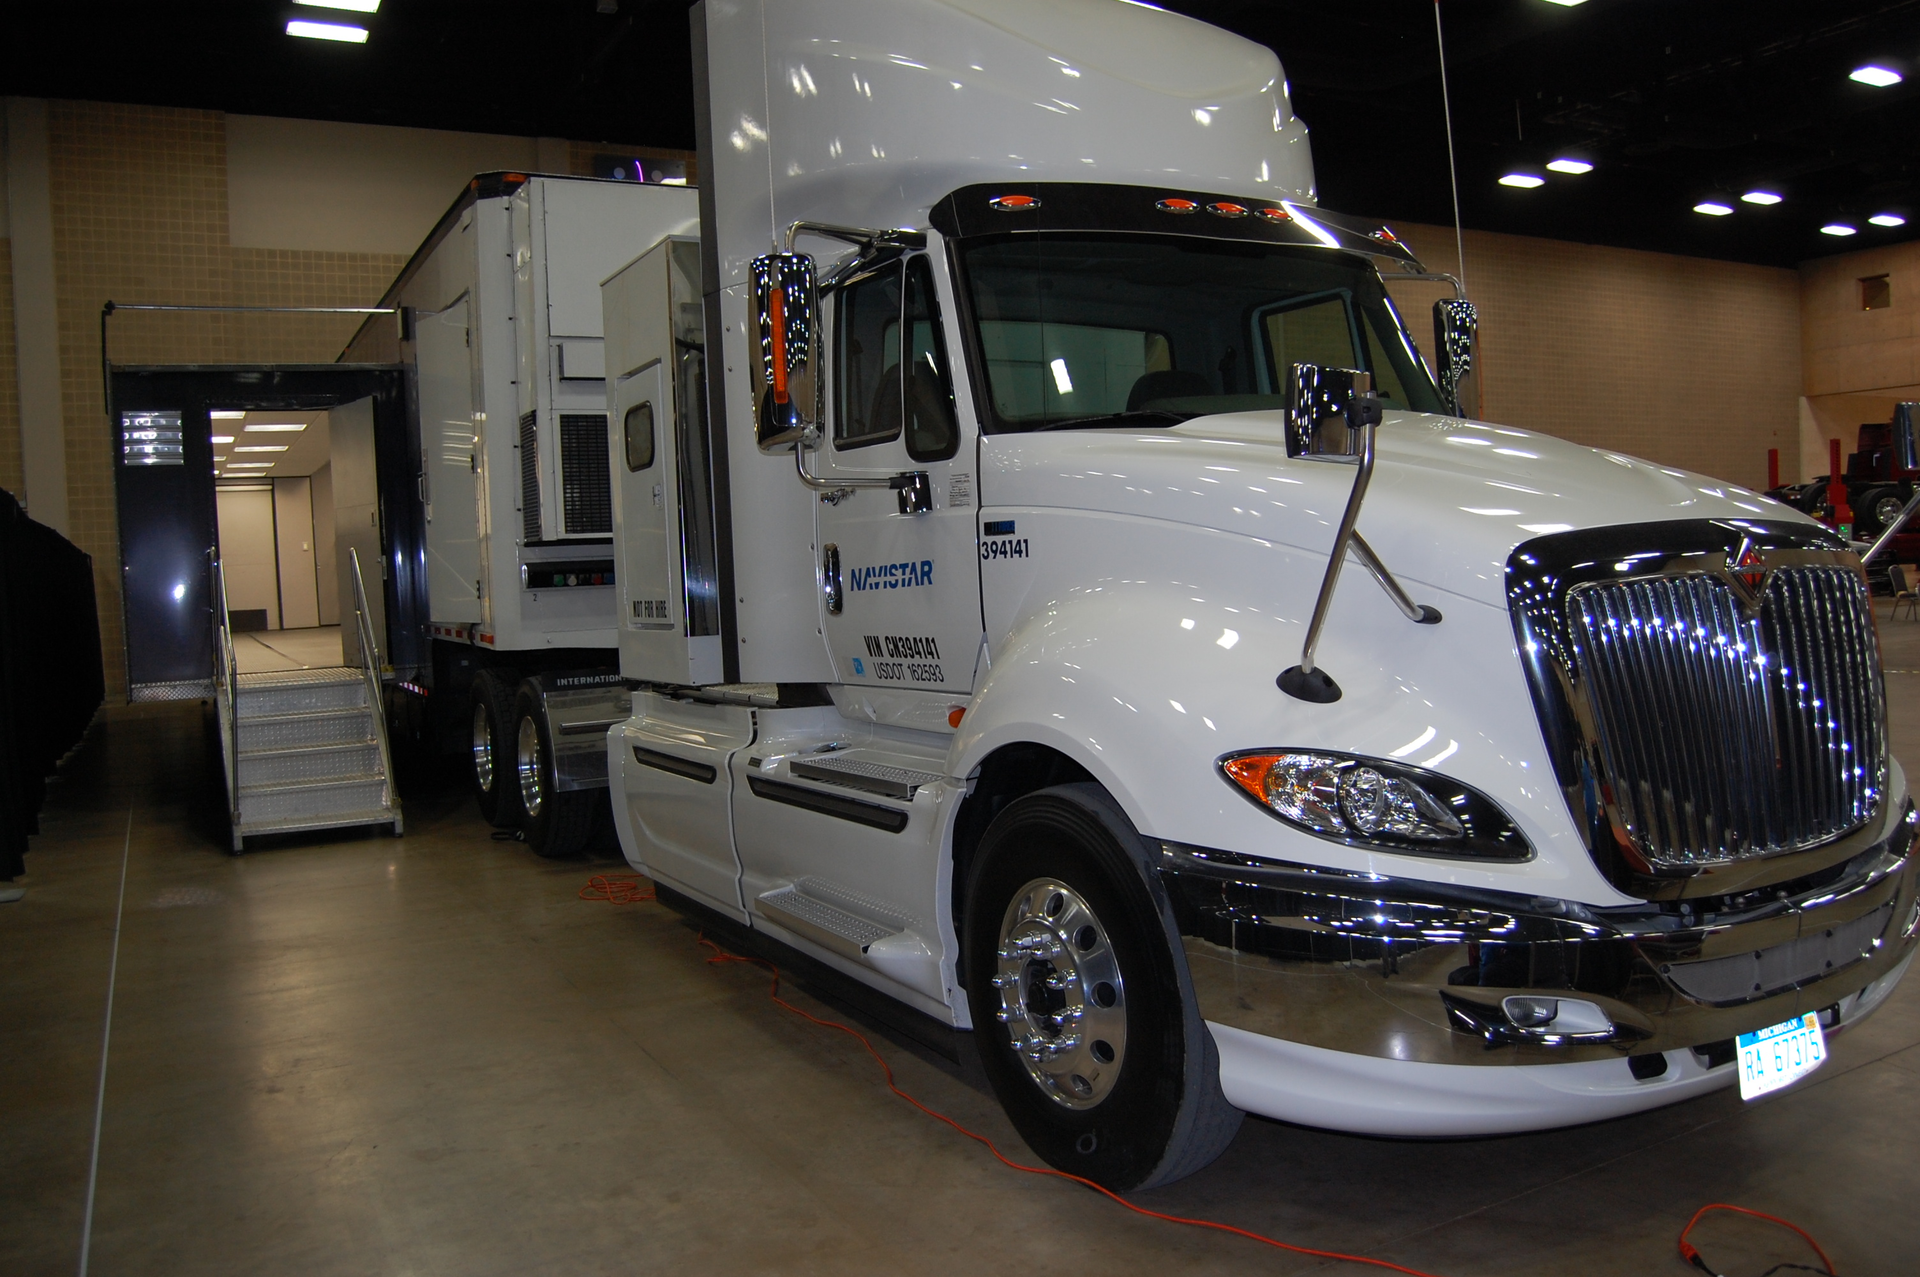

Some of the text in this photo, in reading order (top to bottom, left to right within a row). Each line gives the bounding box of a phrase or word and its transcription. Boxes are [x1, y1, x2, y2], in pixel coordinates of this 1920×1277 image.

[981, 538, 1029, 560] 394141
[850, 559, 933, 592] NAVISTAR
[633, 600, 667, 618] NOT FOR HIRE
[863, 635, 941, 660] VIN CN394141
[557, 674, 626, 687] INTERNATION
[872, 661, 906, 681] USDOT
[907, 663, 945, 683] 162593
[1757, 1018, 1799, 1040] MICHIGAN
[1745, 1047, 1765, 1082] RA
[1773, 1029, 1821, 1073] 67375
